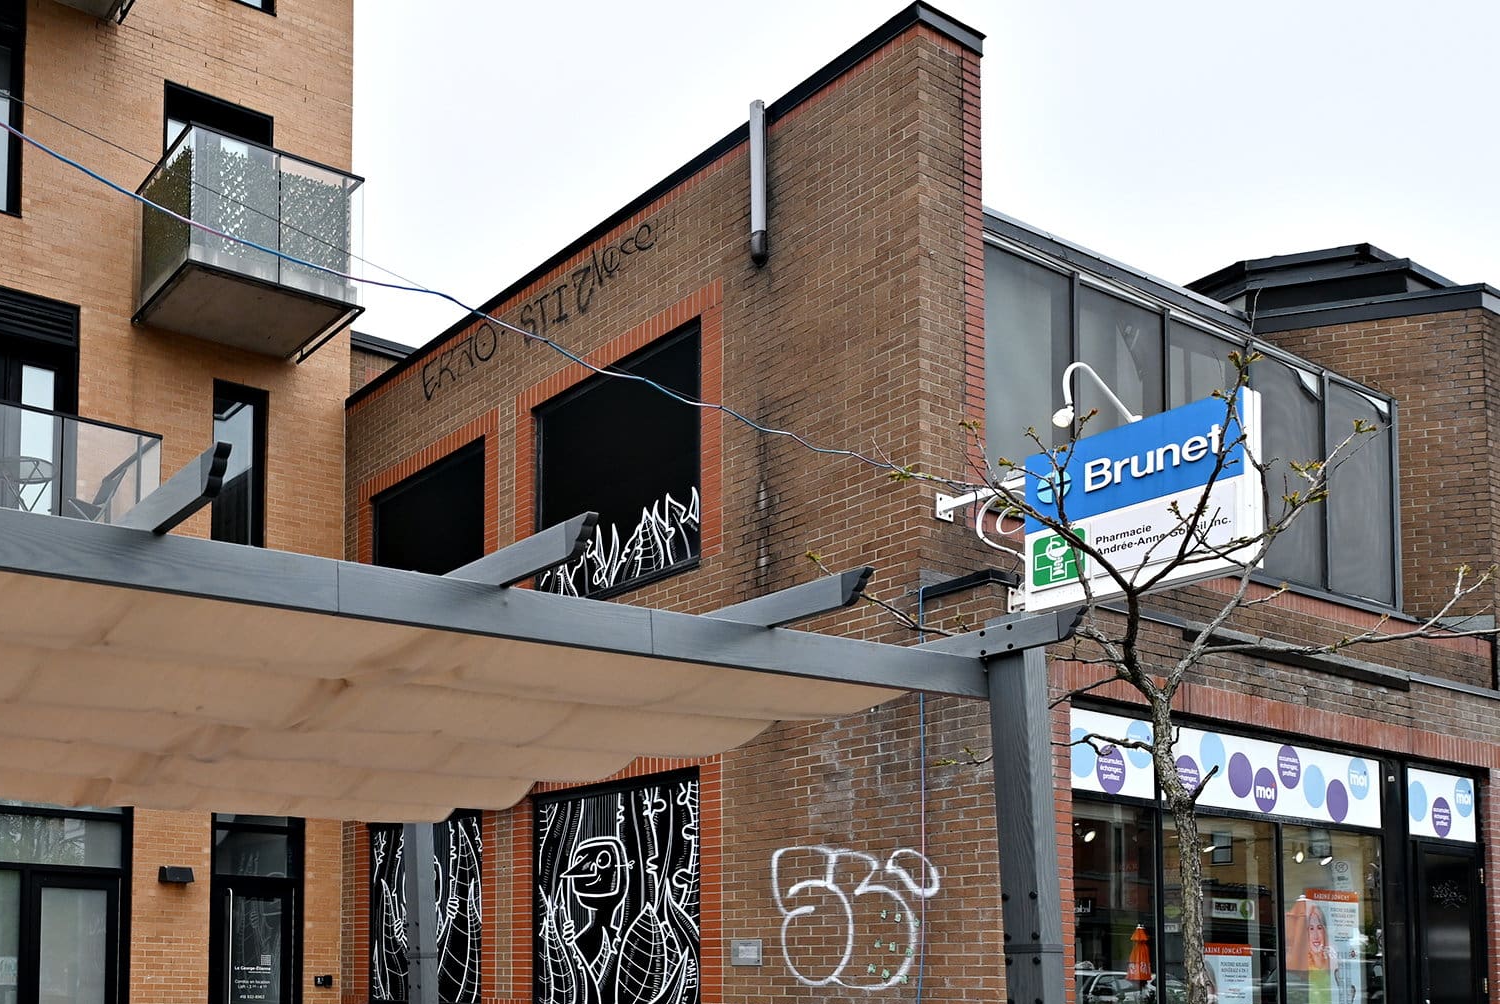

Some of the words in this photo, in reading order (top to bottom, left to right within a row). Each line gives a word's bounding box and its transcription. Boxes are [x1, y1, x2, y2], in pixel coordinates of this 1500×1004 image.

[1084, 423, 1222, 493] Brunet
[1095, 525, 1152, 545] Pharmacie
[1097, 533, 1166, 556] Andrée-Anne
[1169, 520, 1207, 538] Goeil
[1255, 783, 1275, 800] moi
